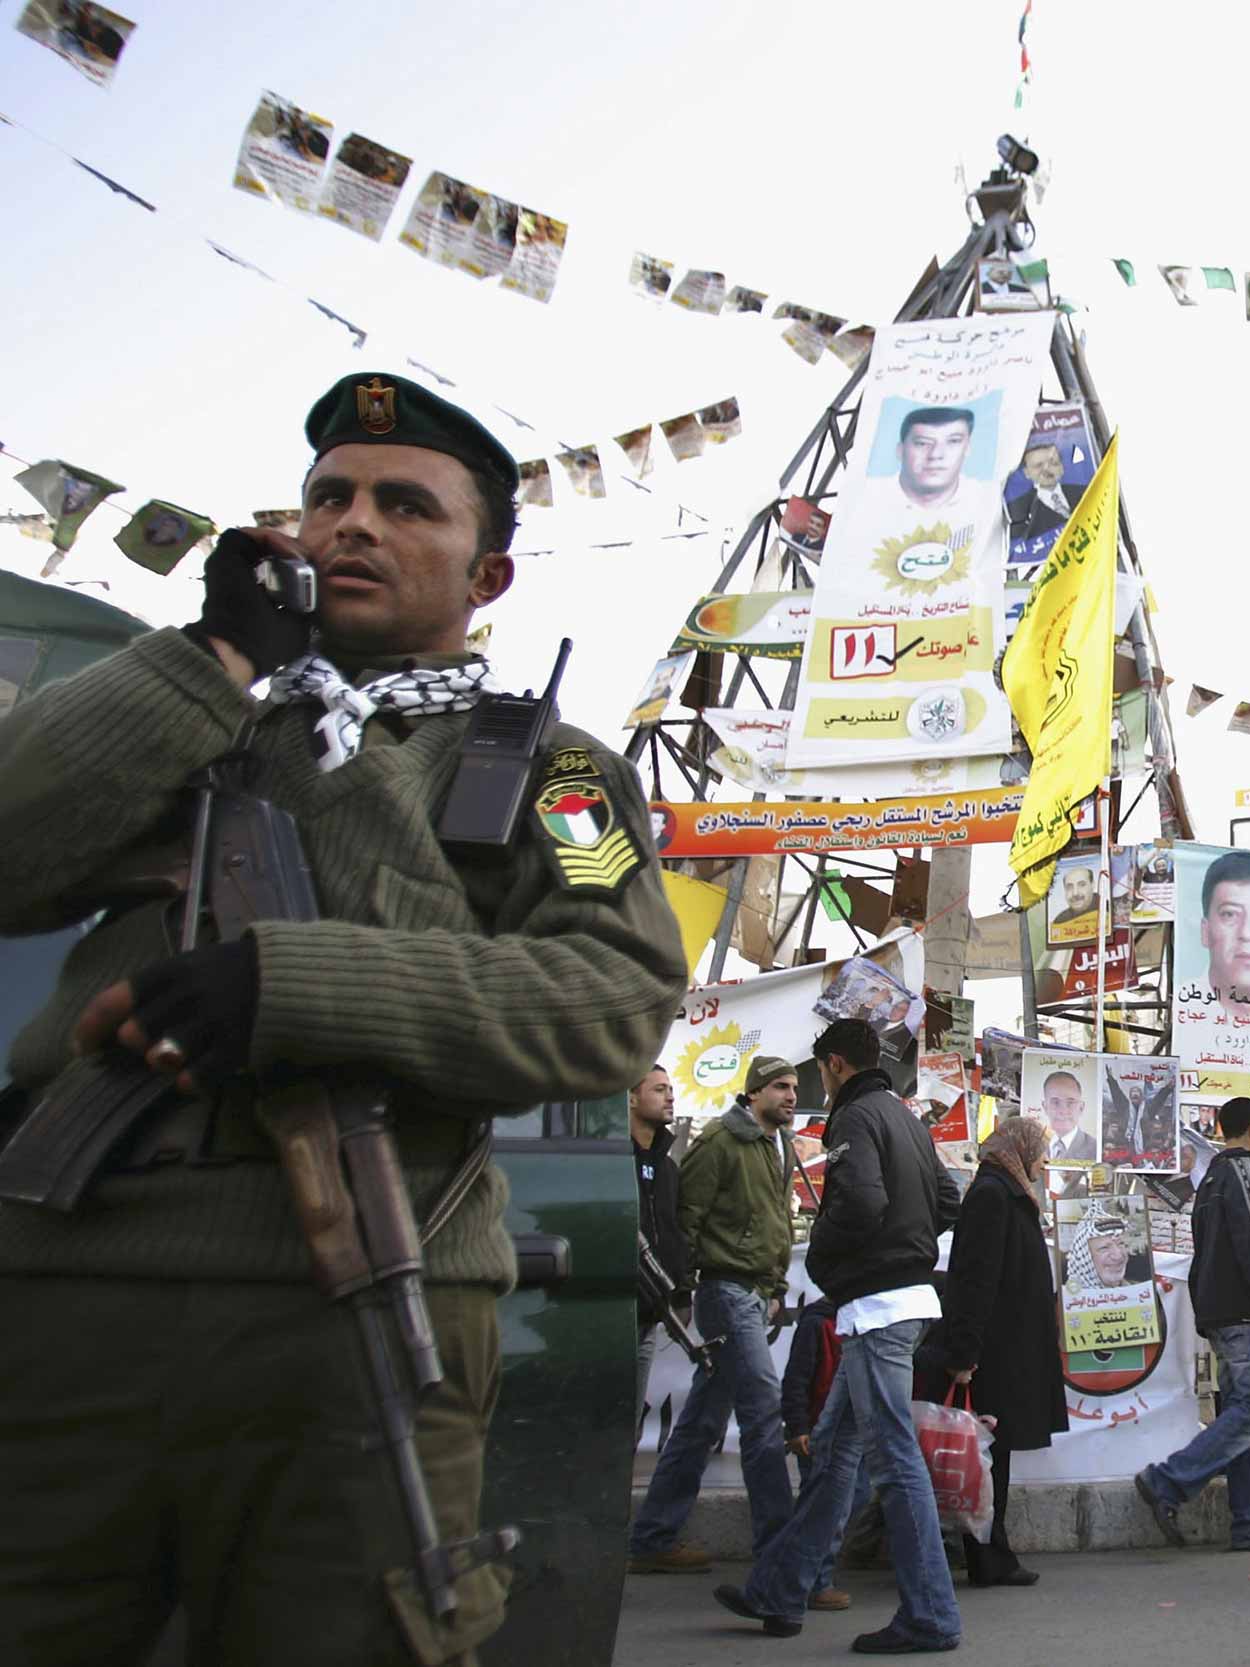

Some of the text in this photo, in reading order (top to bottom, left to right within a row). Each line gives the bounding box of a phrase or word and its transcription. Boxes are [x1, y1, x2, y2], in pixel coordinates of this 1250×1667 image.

[1043, 412, 1081, 430] عصام
[1067, 524, 1091, 566] فتح
[901, 550, 950, 573] فتح
[824, 709, 900, 729] للتشريعي
[777, 811, 827, 832] عصفور
[832, 813, 870, 832] ربحي
[875, 807, 926, 828] المستقل
[931, 800, 975, 824] المرشح
[696, 812, 774, 836] السنجلاوي
[947, 829, 967, 842] نعم
[1178, 983, 1221, 1005] الوطن
[696, 1053, 738, 1078] فتح
[1095, 1327, 1154, 1345] القائمة
[1108, 1391, 1149, 1428] أبو
